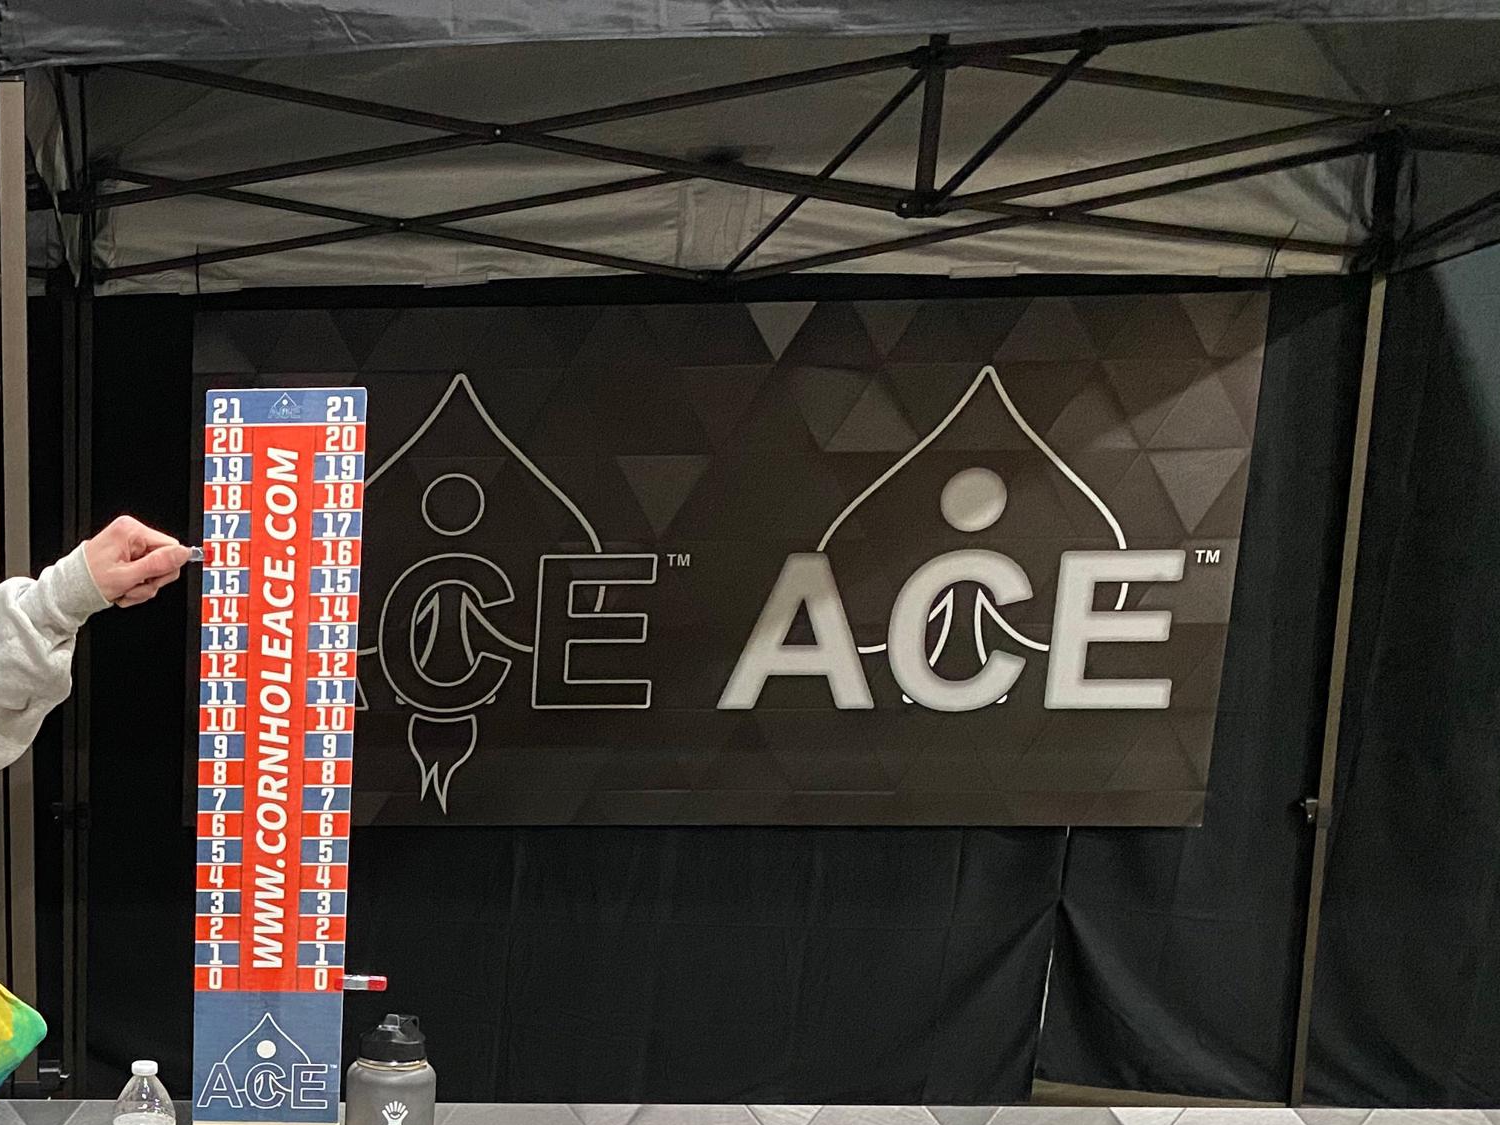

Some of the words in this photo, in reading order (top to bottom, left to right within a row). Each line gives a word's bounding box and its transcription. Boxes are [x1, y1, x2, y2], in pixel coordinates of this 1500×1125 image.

[213, 398, 244, 423] 21
[326, 396, 357, 422] 21
[213, 428, 243, 452] 20
[325, 425, 356, 451] 20
[212, 457, 243, 482] 19
[325, 455, 356, 480] 19
[212, 486, 242, 510] 18
[324, 484, 355, 508] 18
[211, 515, 240, 539] 17
[322, 513, 352, 537] 17
[211, 543, 240, 566] 16
[322, 541, 351, 565] 16
[210, 571, 240, 594] 15
[321, 569, 351, 593] 15
[209, 599, 238, 622] 14
[319, 597, 349, 621] 14
[208, 626, 238, 650] 13
[319, 625, 349, 649] 13
[357, 553, 658, 712] CE
[667, 553, 691, 567] TM
[716, 549, 1186, 712] ACE
[1195, 549, 1221, 564] TM
[207, 654, 237, 677] 12
[318, 653, 348, 676] 12
[207, 682, 236, 704] 11
[316, 681, 346, 704] 11
[253, 447, 298, 968] WWW.CORNHOLEACE.COM
[316, 707, 345, 730] 10
[207, 708, 236, 731] 10
[213, 735, 227, 758] 9
[323, 735, 337, 757] 9
[213, 762, 227, 784] 8
[322, 761, 336, 784] 8
[213, 788, 226, 811] 7
[321, 788, 335, 811] 7
[212, 814, 225, 836] 6
[319, 814, 333, 836] 6
[212, 840, 225, 863] 5
[319, 840, 332, 862] 5
[209, 866, 224, 888] 4
[316, 866, 331, 888] 4
[210, 892, 224, 914] 3
[317, 892, 331, 914] 3
[210, 918, 223, 940] 2
[316, 918, 329, 940] 2
[210, 944, 222, 965] 1
[315, 943, 328, 965] 1
[209, 968, 221, 990] 0
[314, 968, 327, 990] 0
[197, 1062, 328, 1110] ACE
